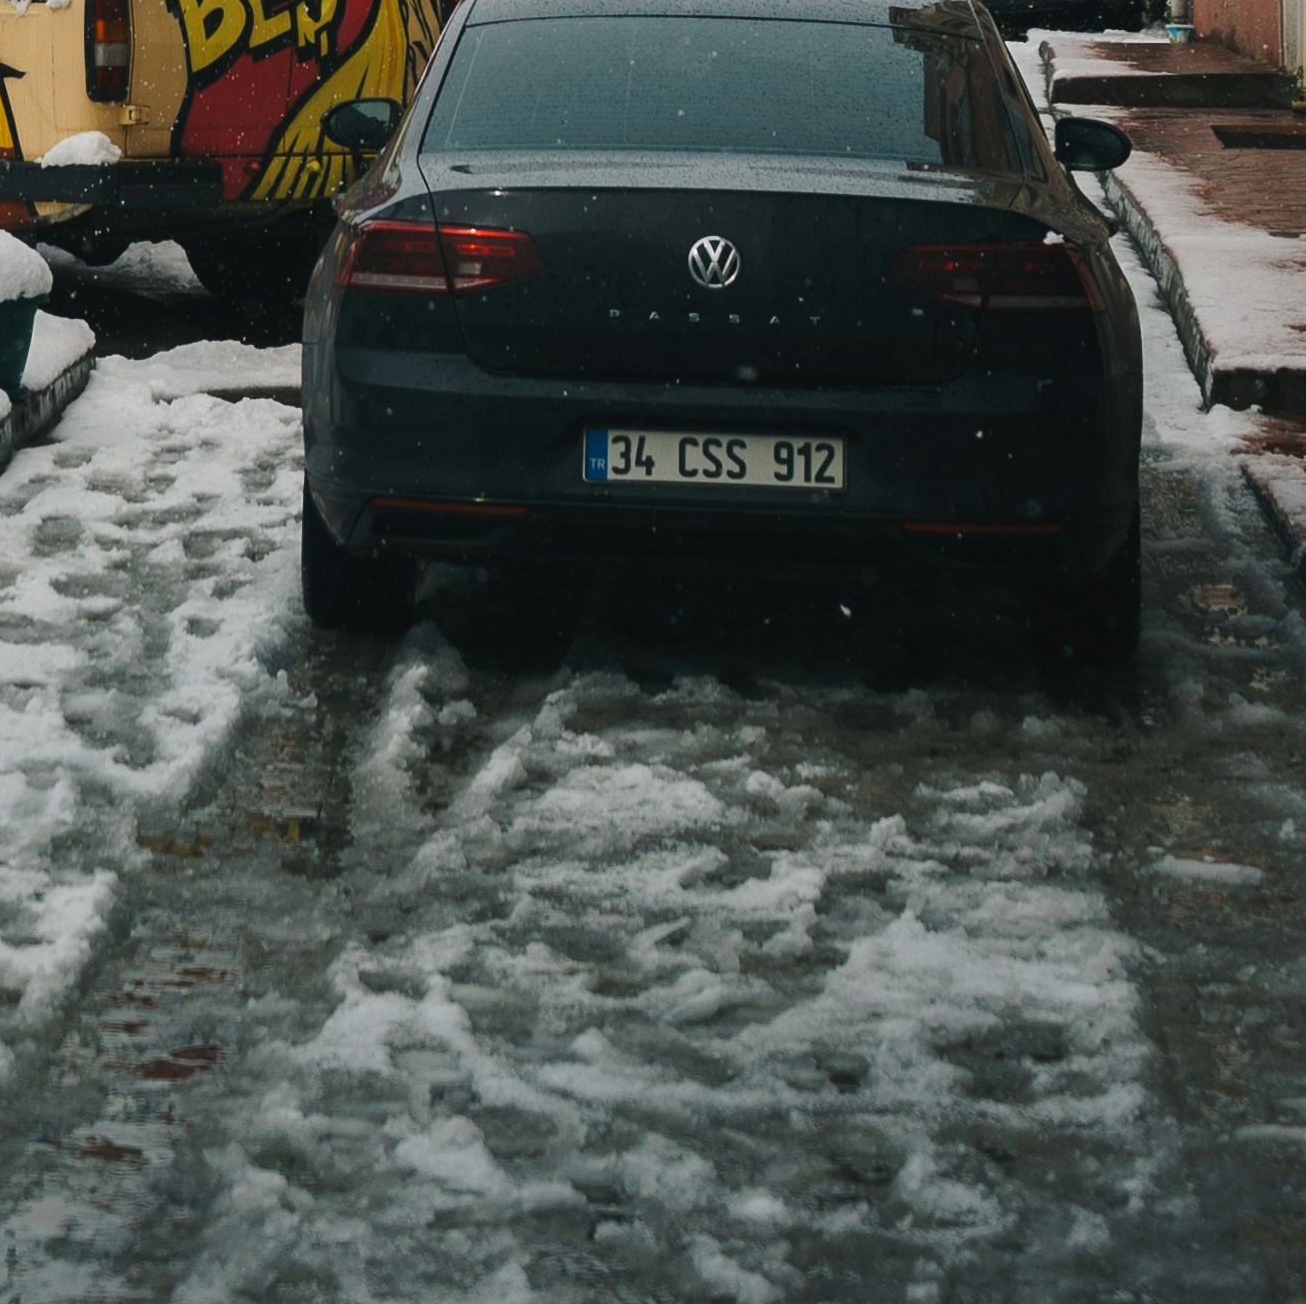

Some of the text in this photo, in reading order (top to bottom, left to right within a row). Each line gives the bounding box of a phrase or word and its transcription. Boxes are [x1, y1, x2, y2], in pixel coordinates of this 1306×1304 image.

[609, 309, 821, 325] PASSAT
[589, 434, 836, 484] TR 34 CSS 912
